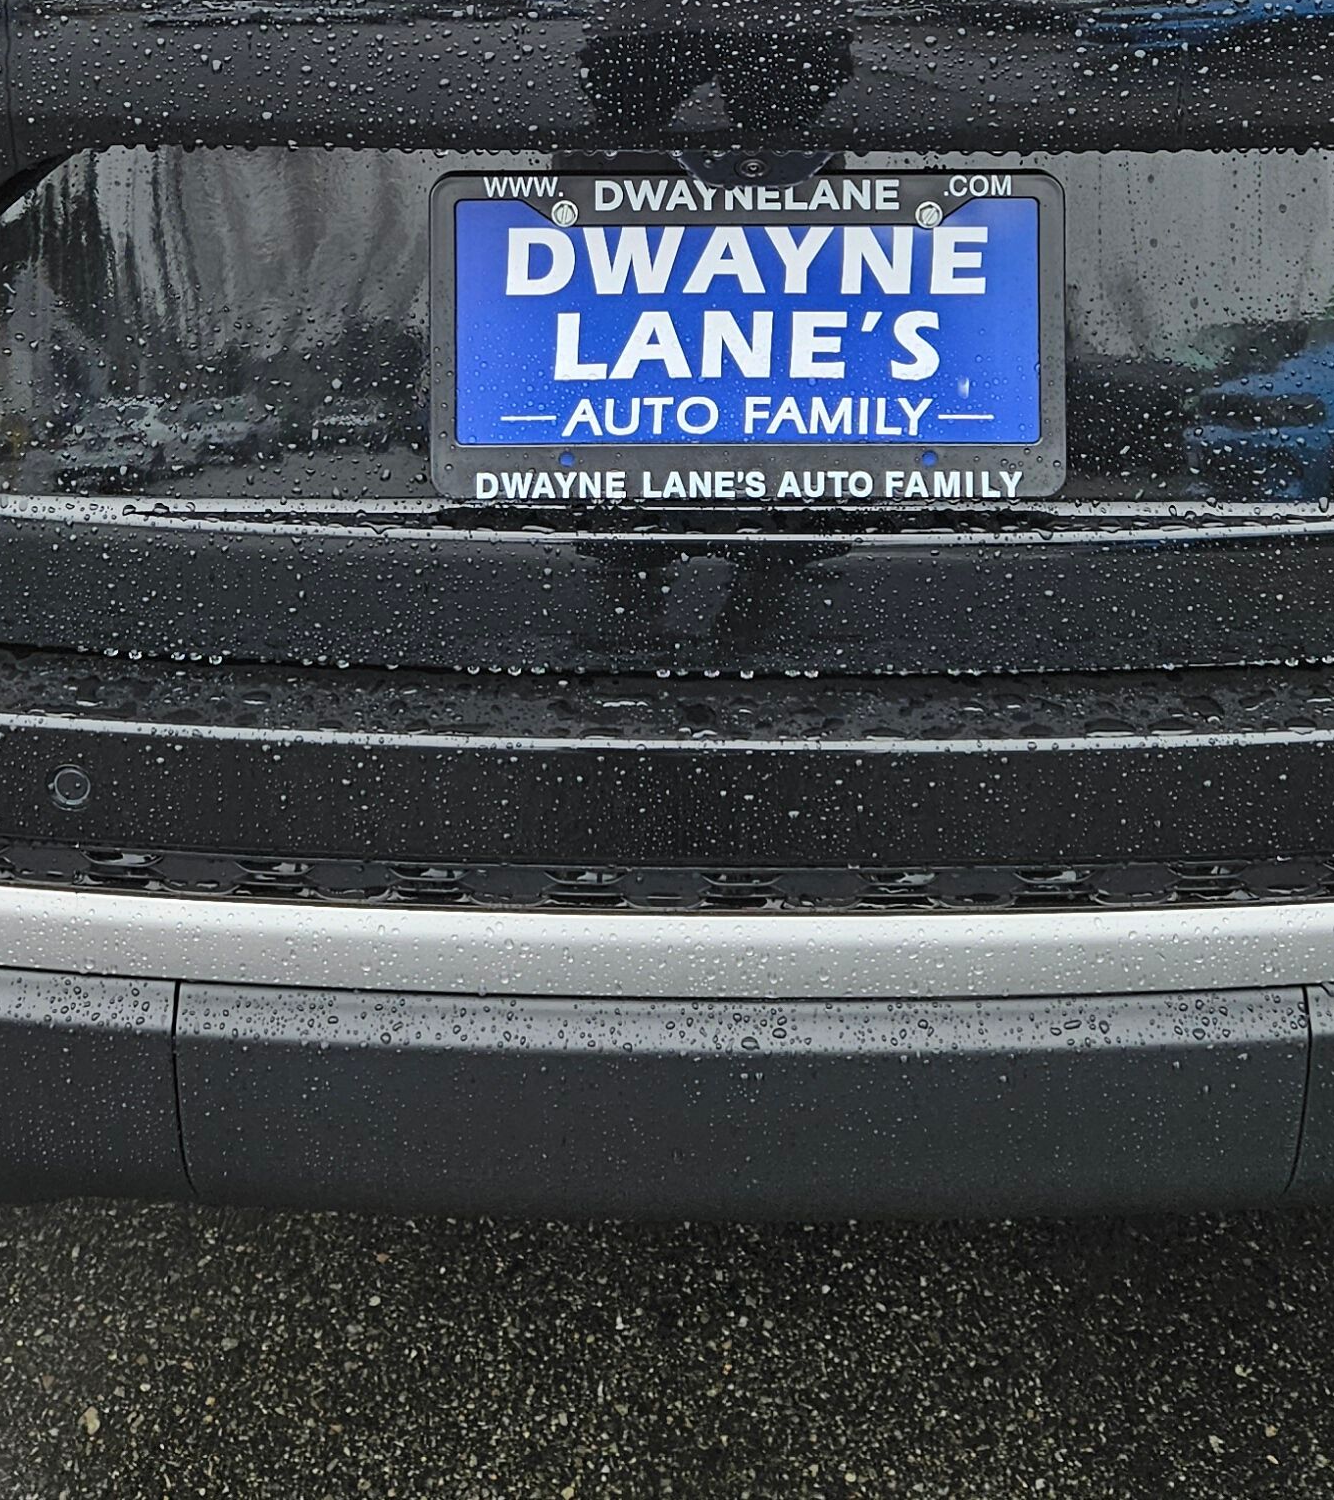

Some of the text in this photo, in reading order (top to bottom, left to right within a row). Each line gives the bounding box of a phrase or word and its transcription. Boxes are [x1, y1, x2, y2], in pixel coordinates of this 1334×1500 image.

[483, 174, 1012, 211] WWW. DWAYNELANE .COM
[505, 226, 988, 296] DWAYNE
[553, 310, 940, 381] LANE'S
[561, 396, 933, 437] AUTO FAMILY
[475, 470, 1023, 499] DWAYNE LANE'S AUTO FAMILY
